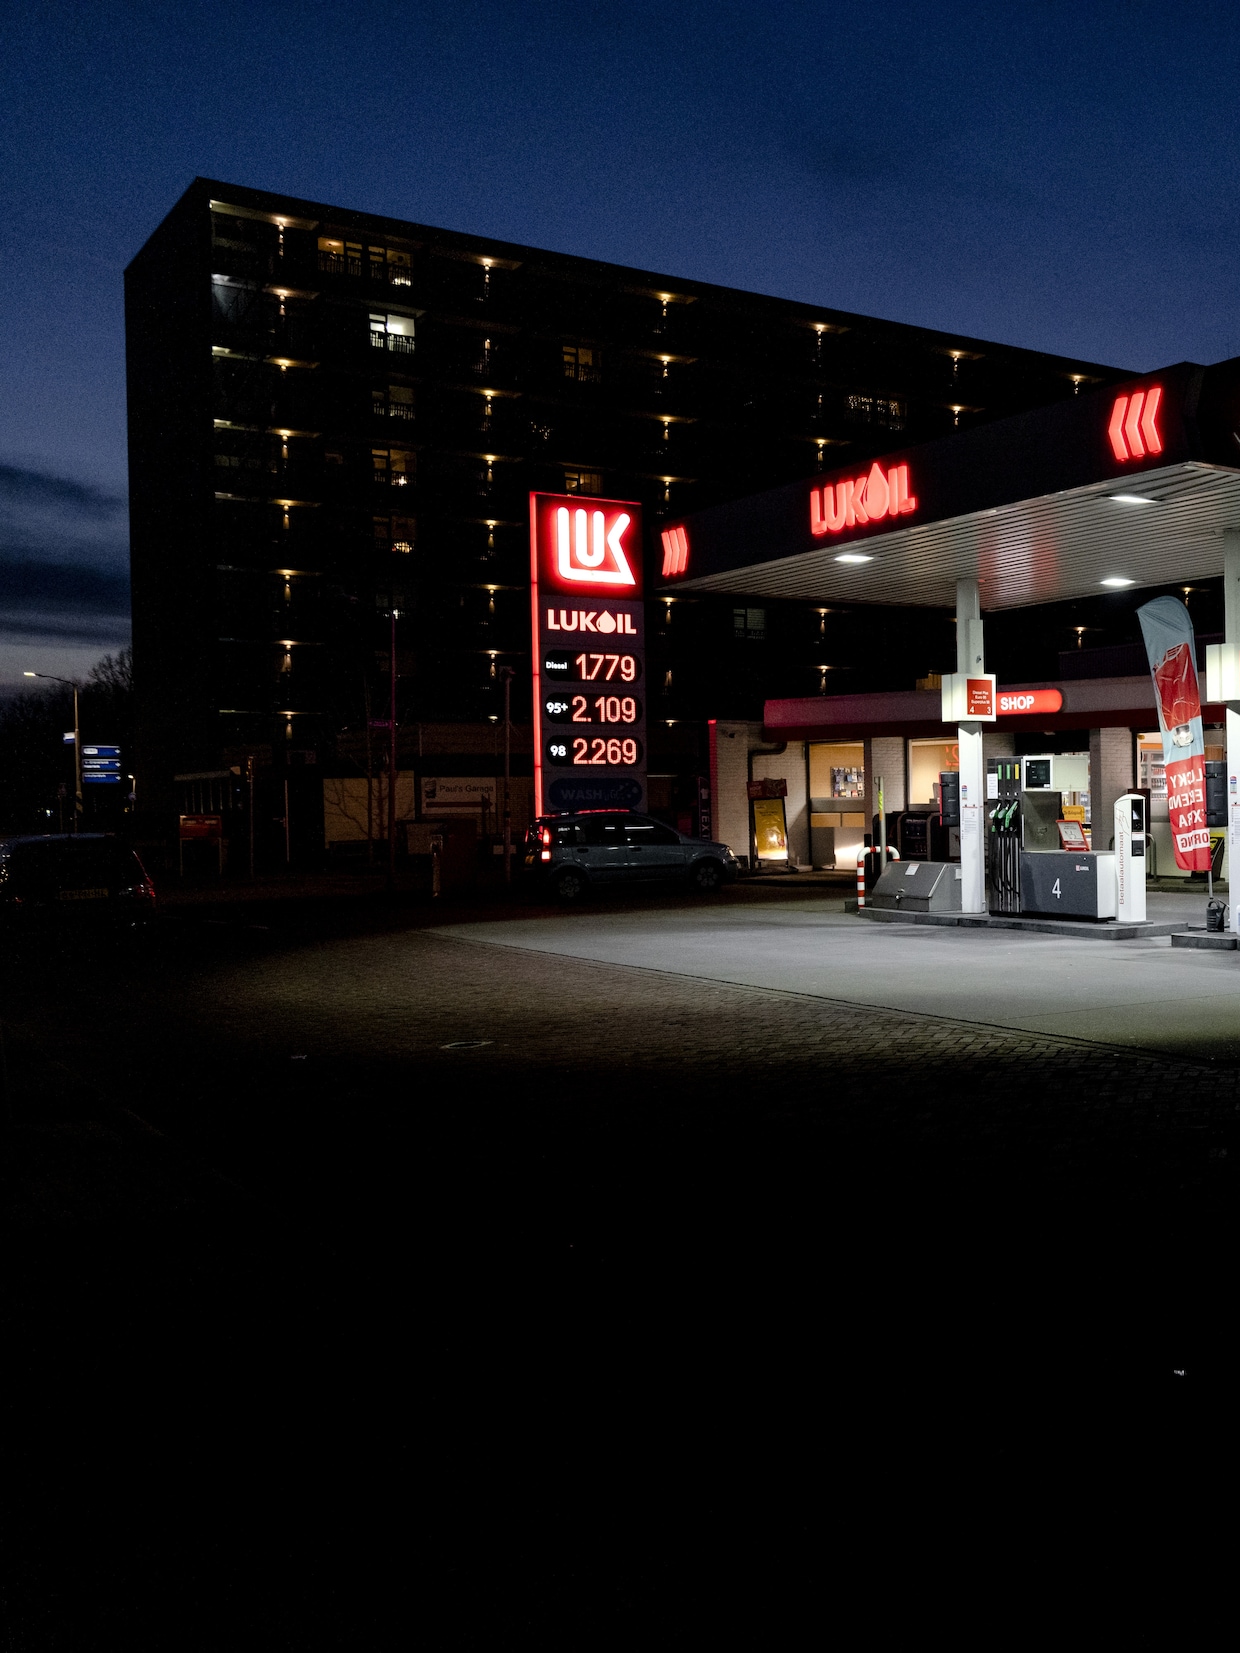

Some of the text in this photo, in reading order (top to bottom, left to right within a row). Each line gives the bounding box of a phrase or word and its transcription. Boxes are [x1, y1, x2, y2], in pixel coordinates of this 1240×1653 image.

[809, 462, 916, 535] LUKOIL
[547, 608, 637, 635] LUKOIL
[545, 661, 568, 670] Diesel
[545, 702, 568, 714] 95+
[1000, 695, 1035, 710] SHOP
[969, 705, 992, 714] 4 3
[549, 744, 567, 757] 98
[439, 784, 463, 792] Paul's
[1051, 878, 1062, 899] 4
